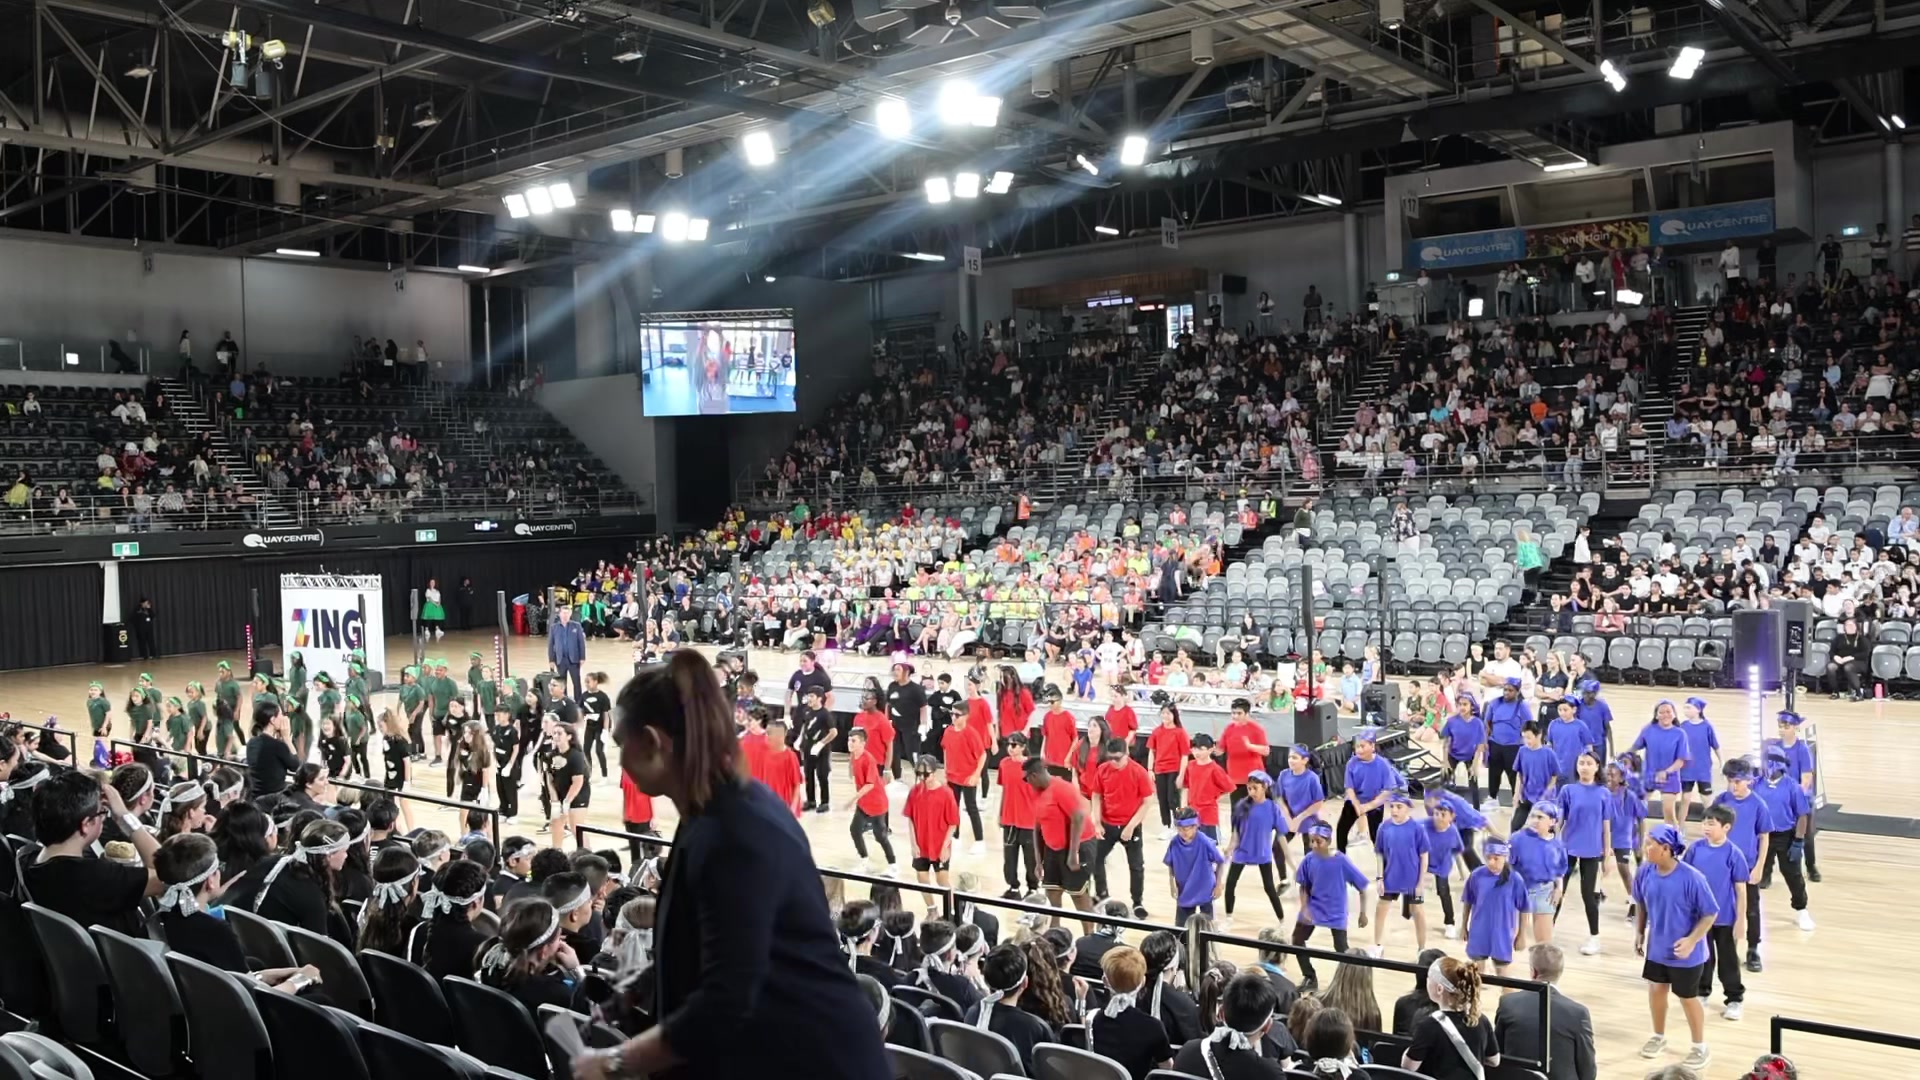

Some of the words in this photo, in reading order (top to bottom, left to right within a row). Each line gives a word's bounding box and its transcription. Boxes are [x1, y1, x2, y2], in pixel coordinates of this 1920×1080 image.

[1658, 214, 1769, 236] QUAYCENTRE
[1165, 230, 1175, 245] 16
[1420, 242, 1512, 261] QUAYCENTRE
[968, 258, 979, 272] 15
[514, 522, 574, 536] QUAYCENTRE
[243, 532, 322, 548] QUAYCENTRE
[291, 608, 363, 651] ZING
